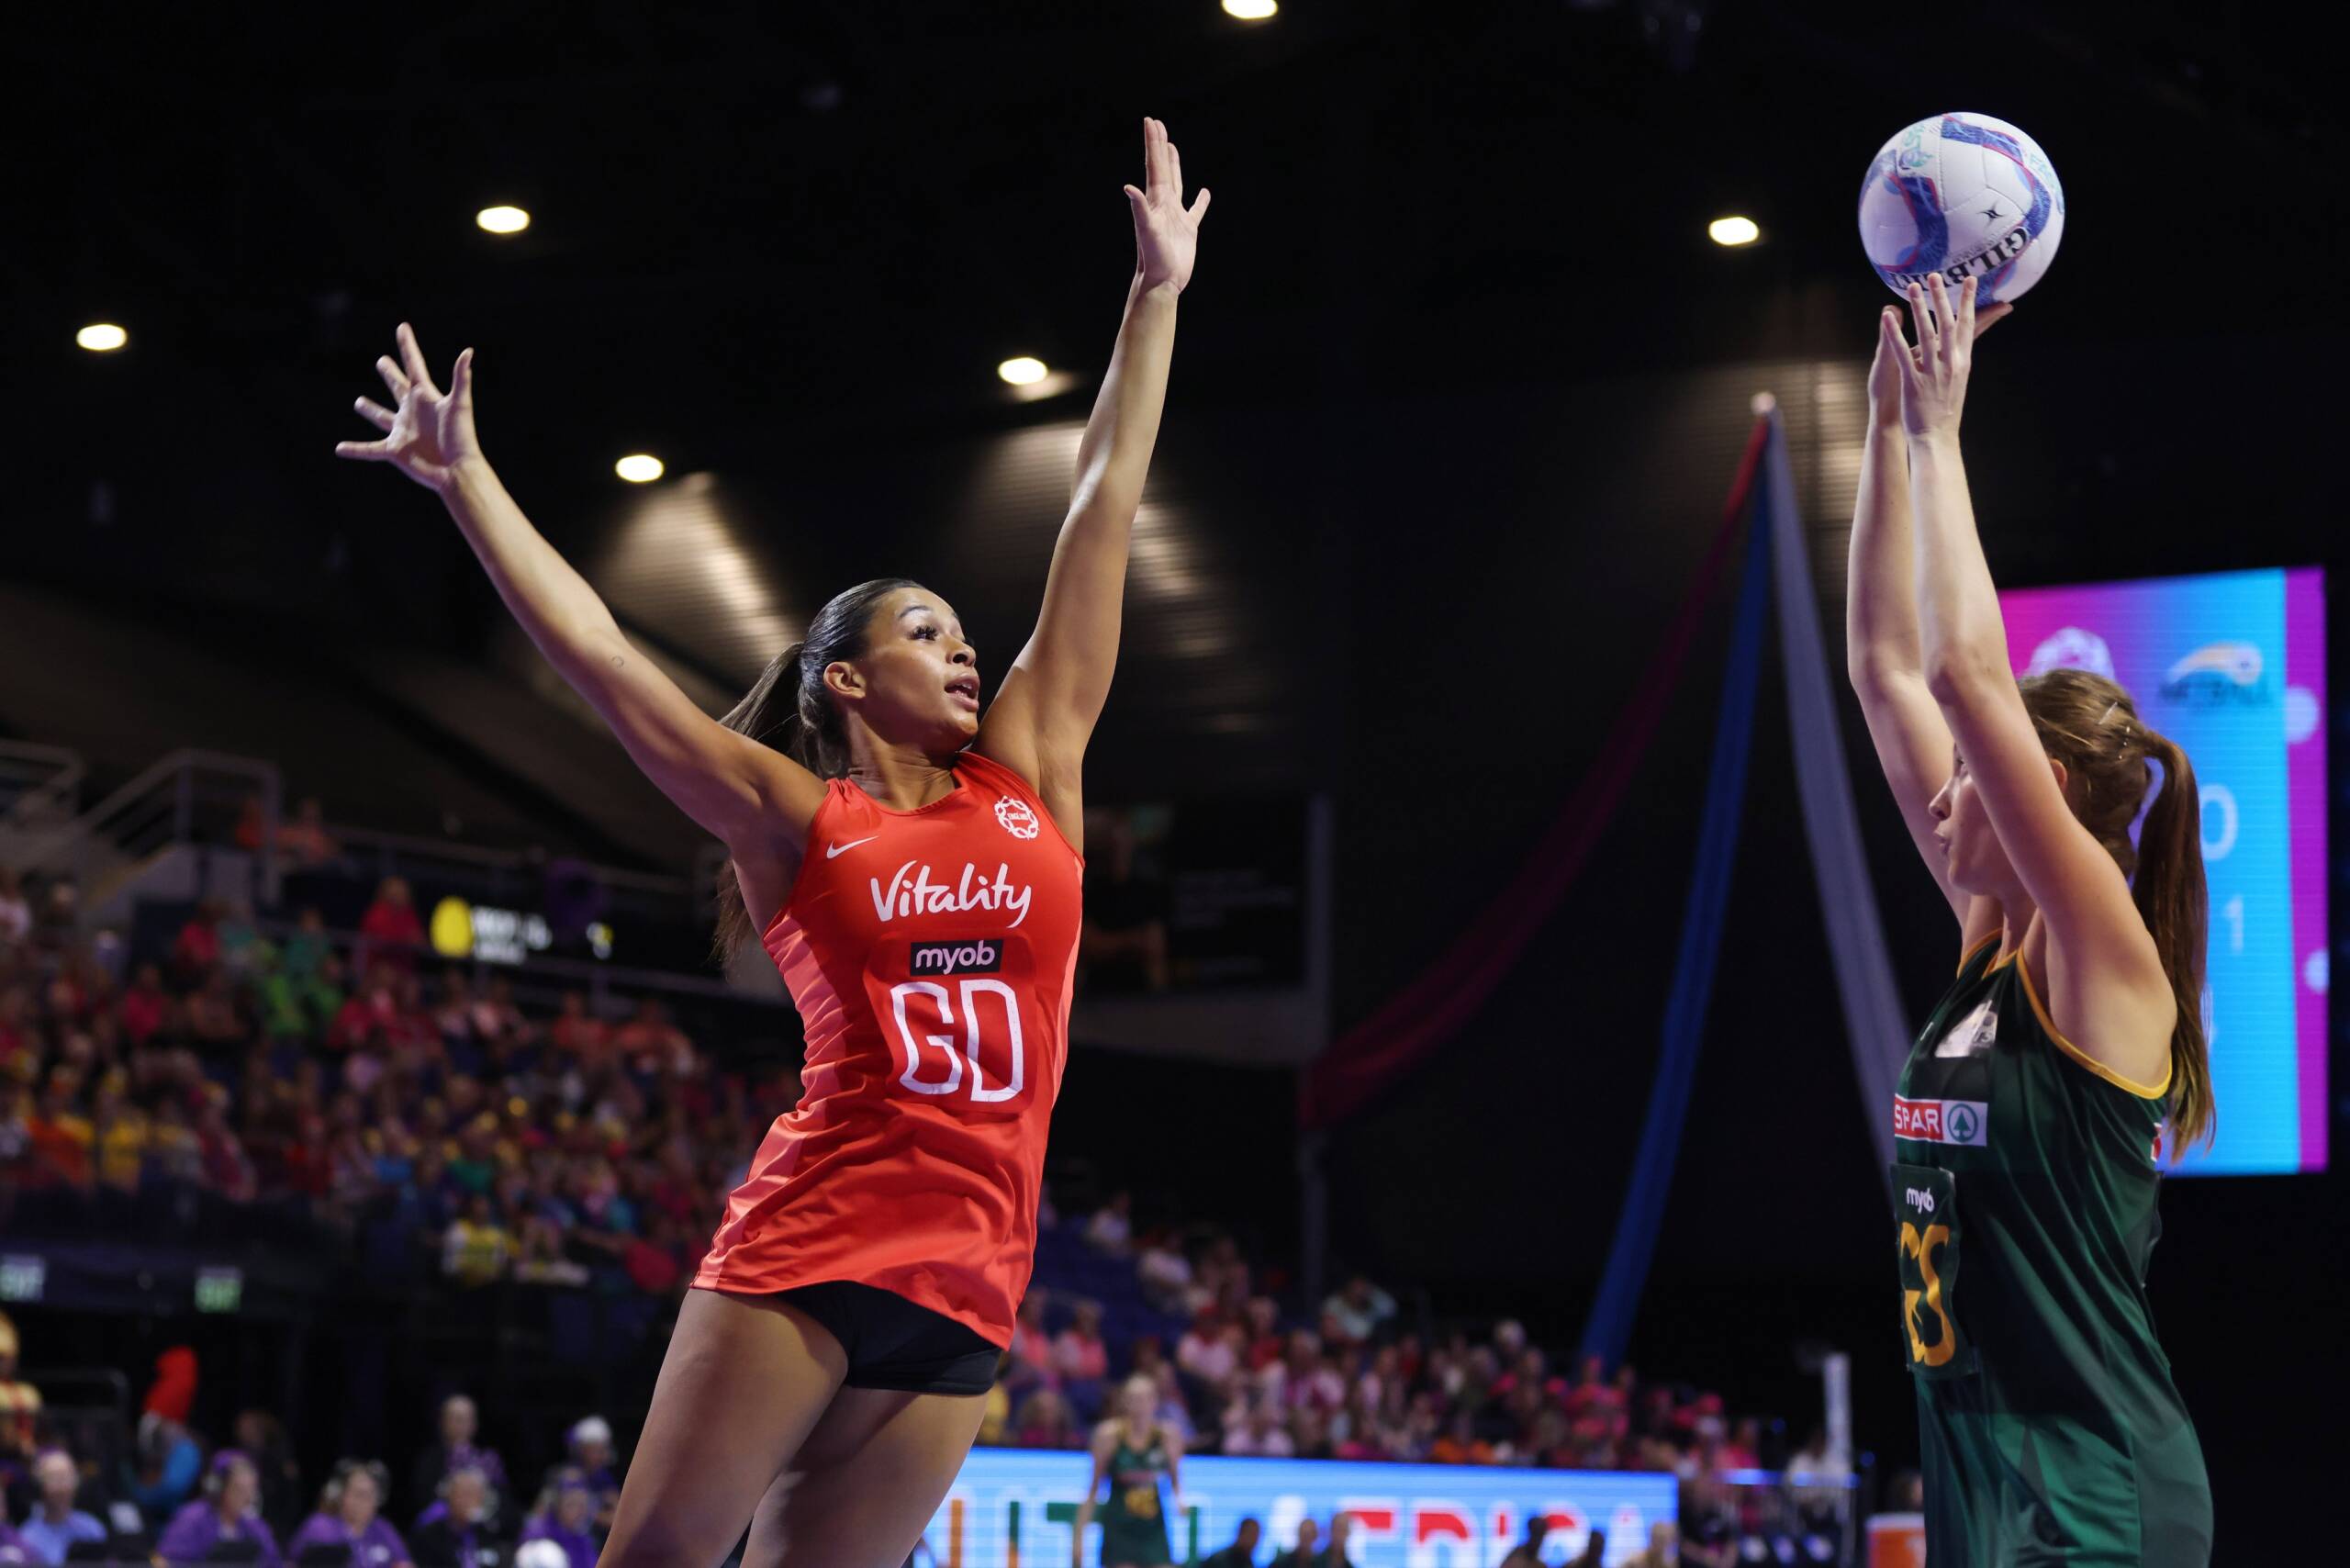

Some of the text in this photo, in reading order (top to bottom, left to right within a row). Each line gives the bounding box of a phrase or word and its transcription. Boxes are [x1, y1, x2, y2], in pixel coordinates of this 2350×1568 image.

[1890, 228, 2029, 292] GILBRT
[870, 860, 1031, 928] Vitality
[915, 939, 996, 975] myob
[890, 979, 1024, 1103] GD
[1895, 1103, 1940, 1133] SPAR
[1906, 1187, 1935, 1215] myob
